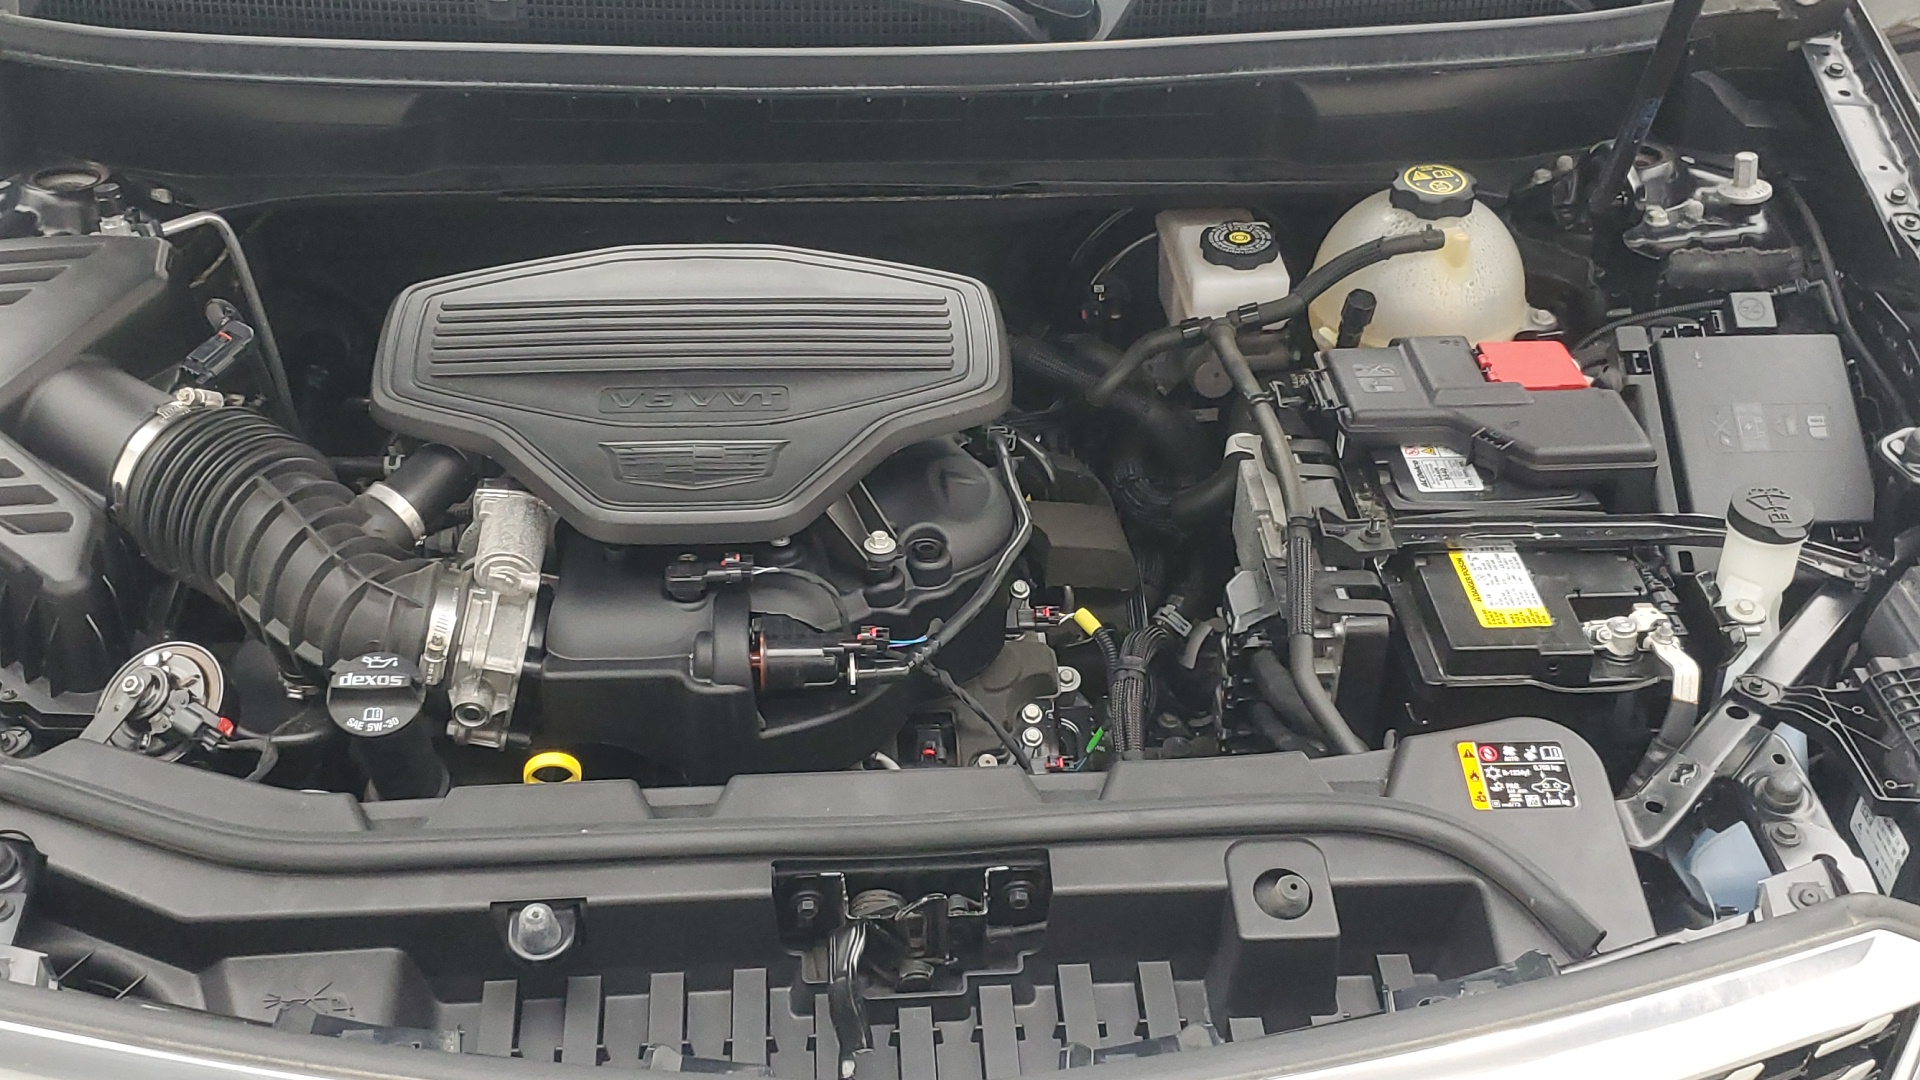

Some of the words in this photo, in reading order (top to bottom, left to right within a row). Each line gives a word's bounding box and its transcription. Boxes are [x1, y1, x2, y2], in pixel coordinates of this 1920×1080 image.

[609, 392, 674, 408] V6
[685, 391, 782, 407] VVT
[339, 673, 405, 686] dexos
[347, 717, 364, 730] SAE
[366, 717, 400, 731] 5W-30
